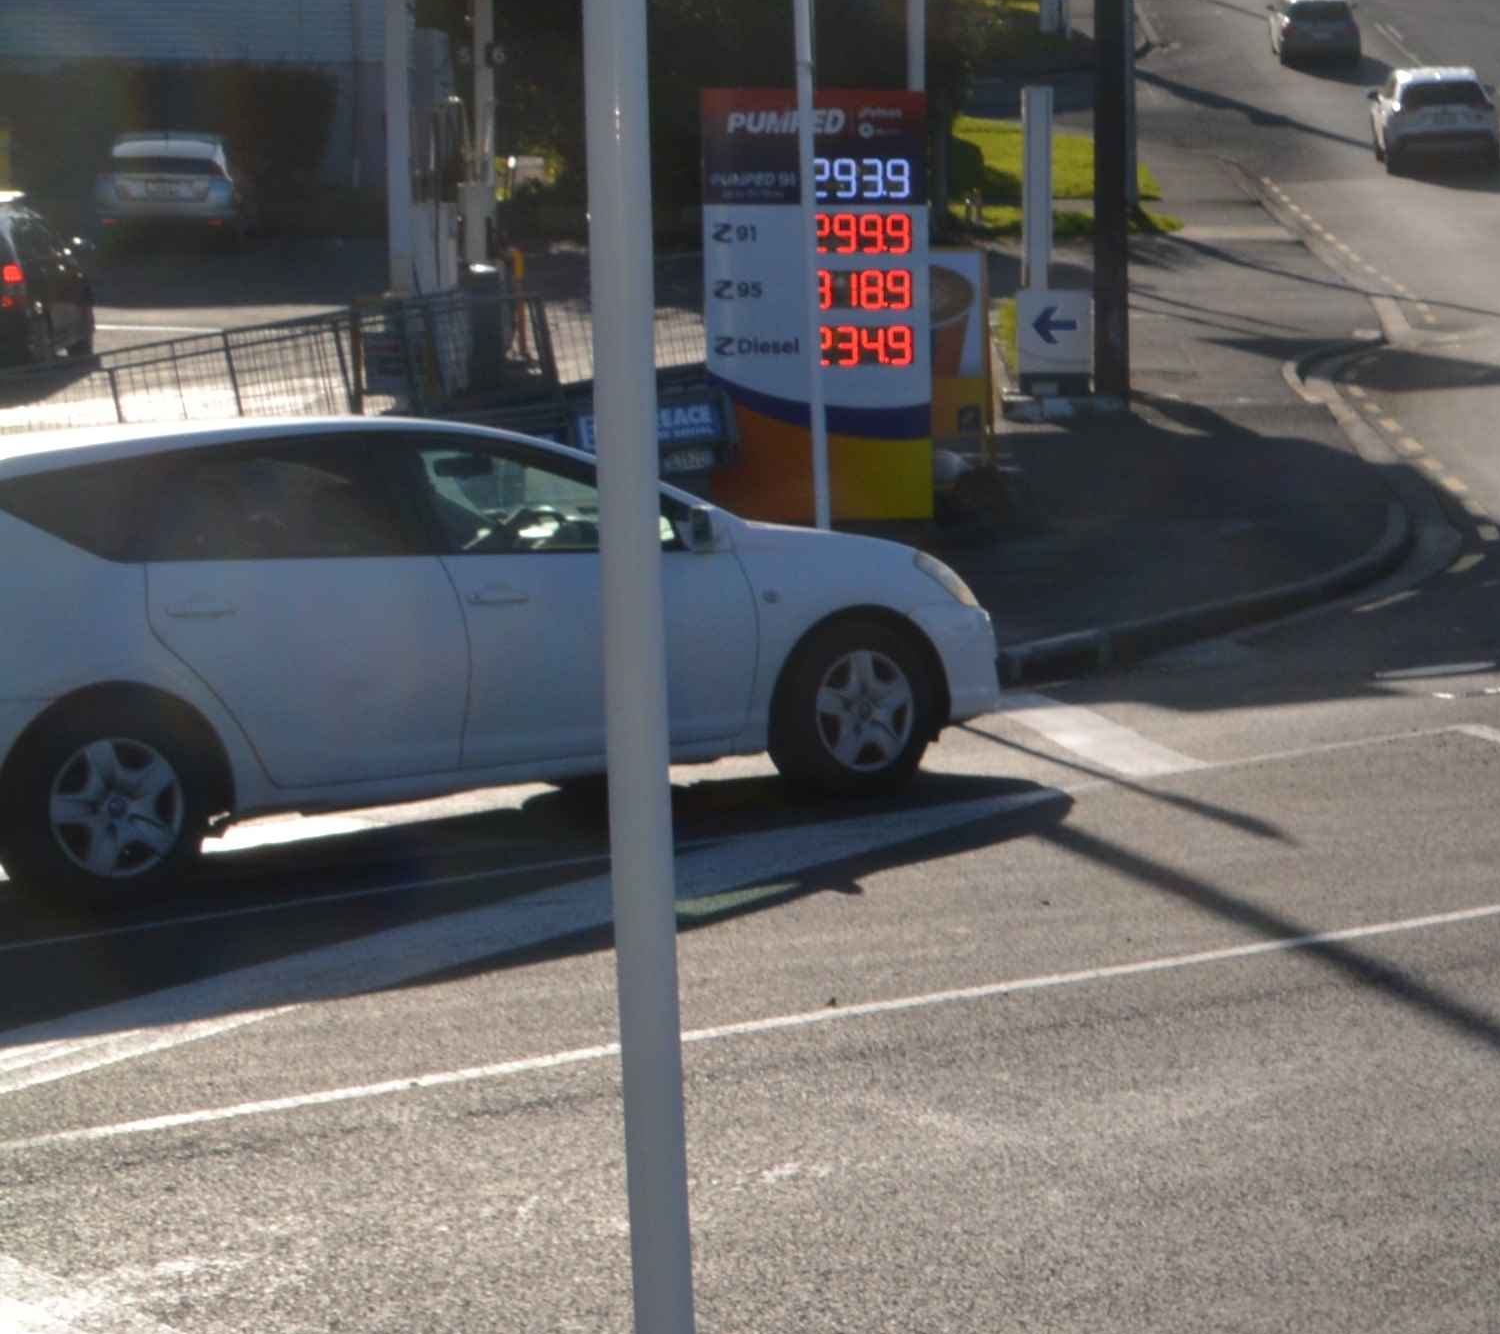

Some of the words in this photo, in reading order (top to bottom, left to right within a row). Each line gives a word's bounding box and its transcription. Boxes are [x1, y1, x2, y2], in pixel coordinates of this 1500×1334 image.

[813, 158, 910, 198] 293.9
[736, 224, 757, 242] 91
[815, 213, 911, 254] 299.9
[737, 281, 763, 299] 95
[738, 336, 799, 355] Diesel
